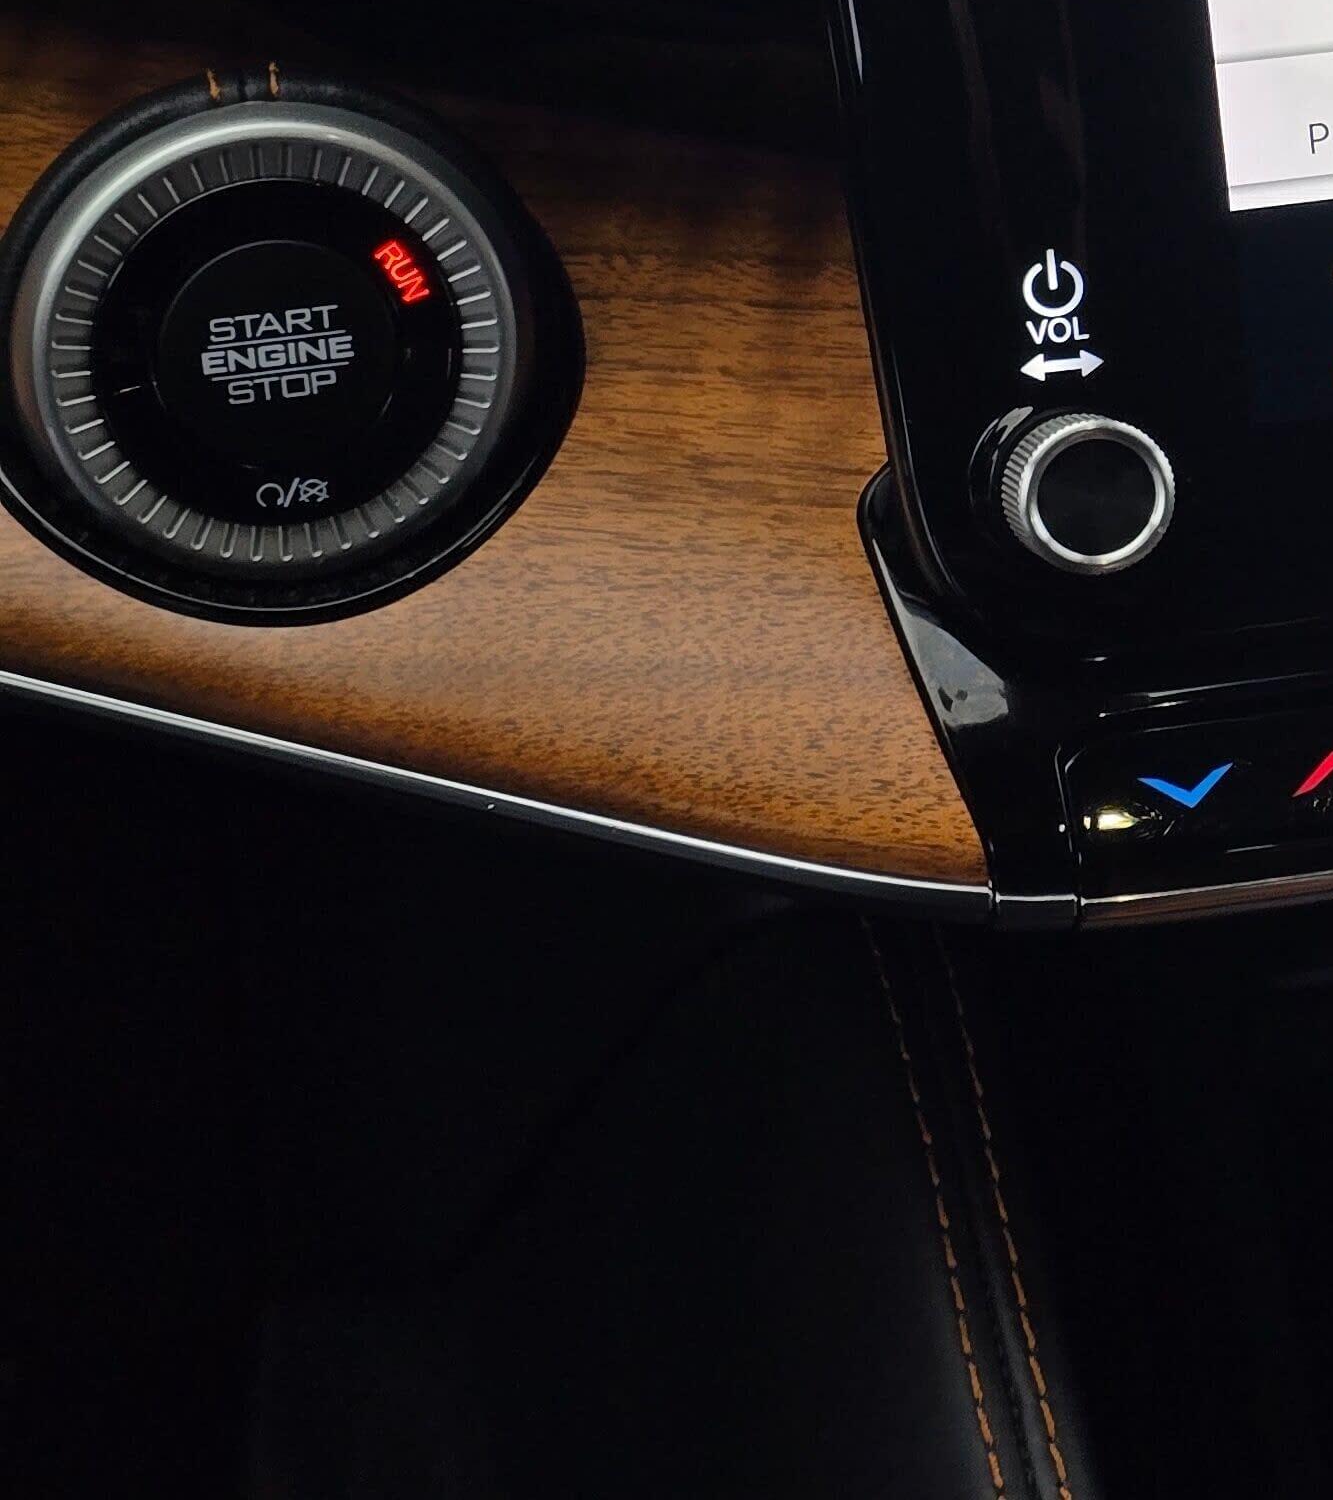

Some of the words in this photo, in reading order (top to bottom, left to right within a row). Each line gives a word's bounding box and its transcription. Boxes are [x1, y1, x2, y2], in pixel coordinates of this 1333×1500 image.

[373, 240, 430, 303] RUN
[210, 305, 338, 342] START
[1025, 317, 1090, 344] VOL
[201, 337, 355, 375] ENGINE
[228, 370, 337, 404] STOP
